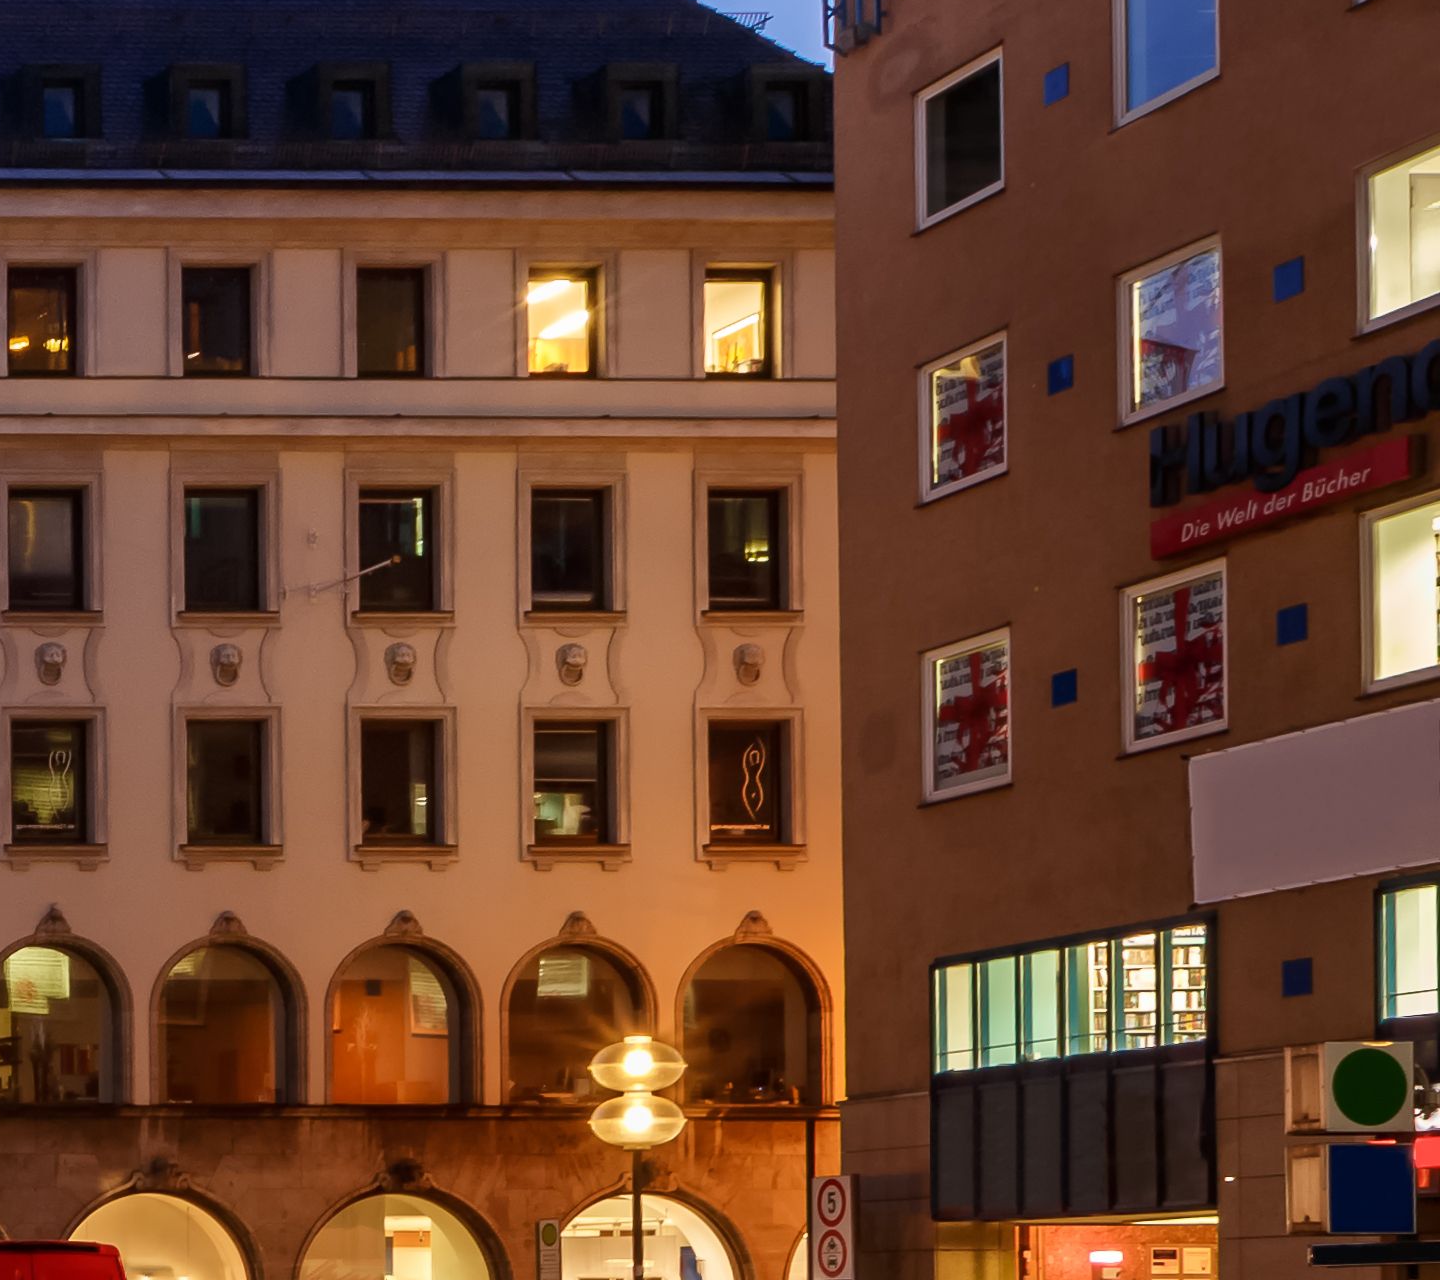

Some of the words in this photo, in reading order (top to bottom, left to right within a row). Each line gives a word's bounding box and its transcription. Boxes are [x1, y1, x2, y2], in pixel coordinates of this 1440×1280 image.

[1180, 519, 1211, 544] Die
[1217, 502, 1258, 531] Welt
[1264, 491, 1296, 516] der
[1302, 465, 1372, 503] Bücher
[827, 1192, 836, 1213] 5
